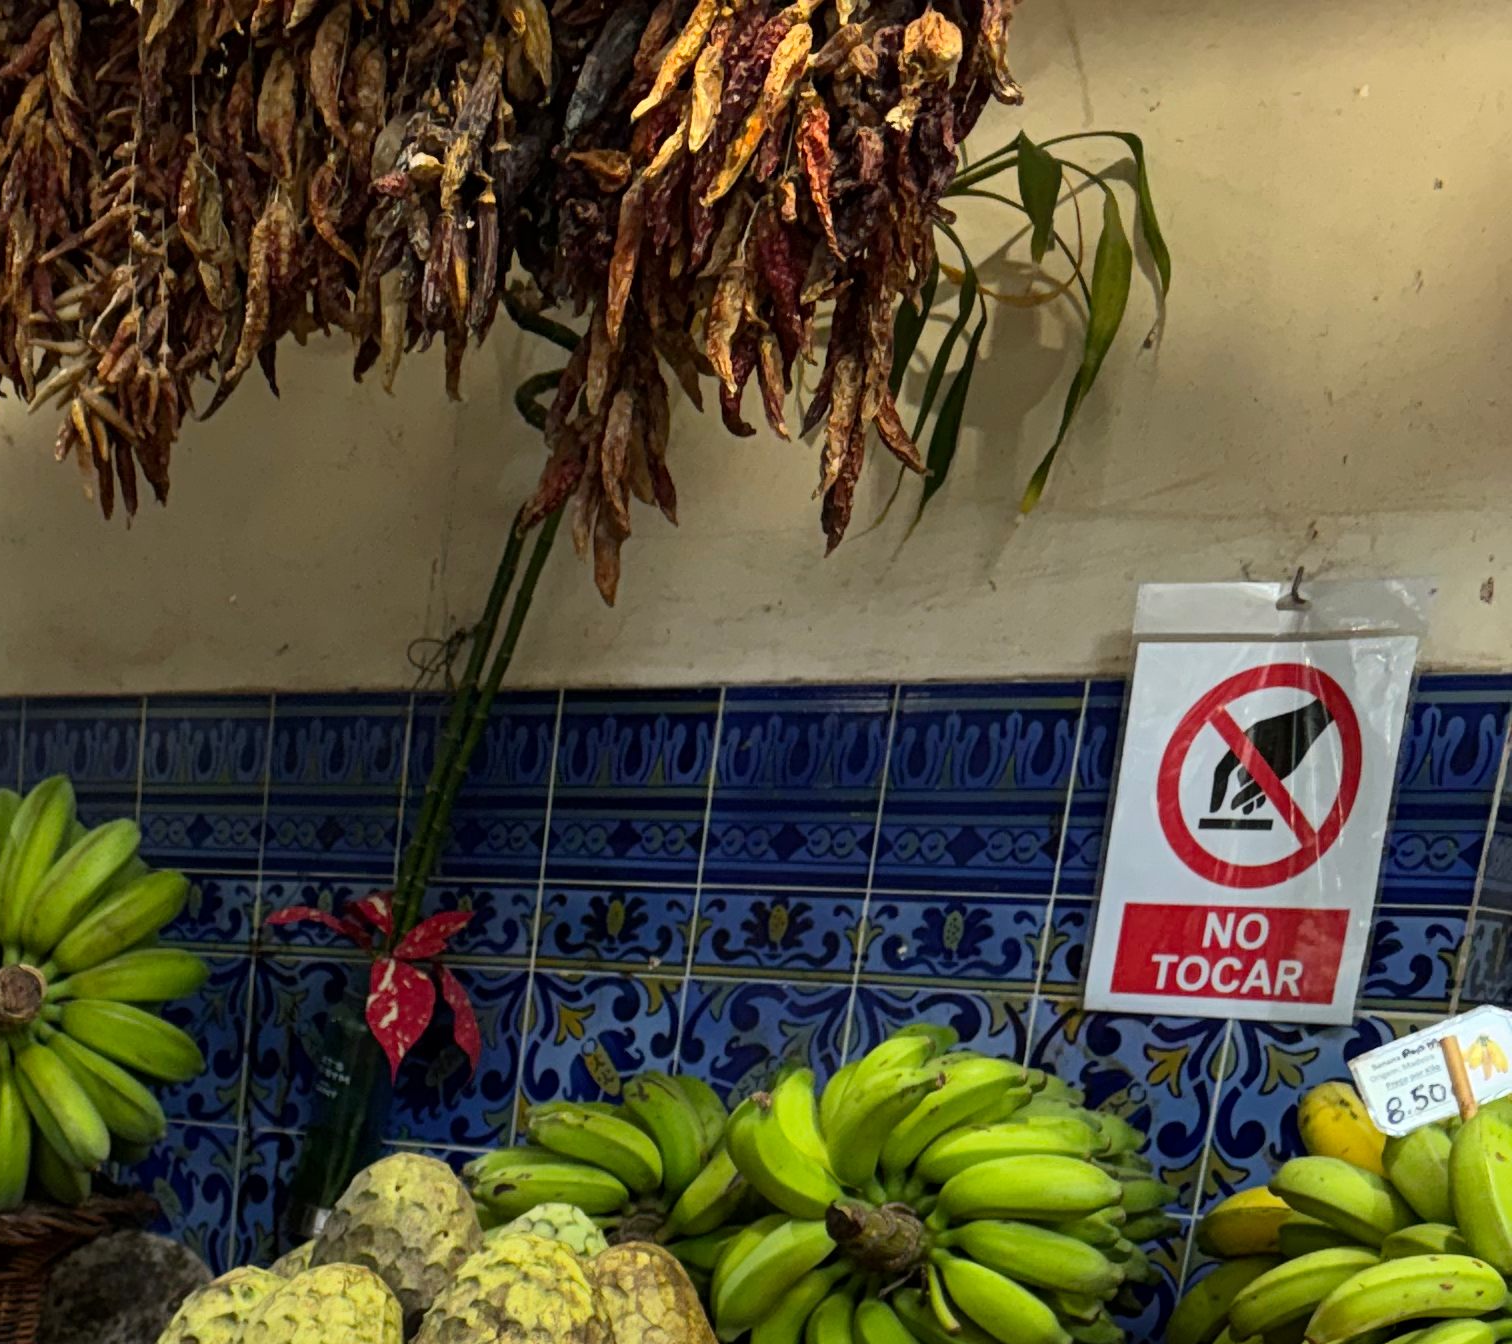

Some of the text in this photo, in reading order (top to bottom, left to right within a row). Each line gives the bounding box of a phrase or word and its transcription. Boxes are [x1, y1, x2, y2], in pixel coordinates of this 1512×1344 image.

[1202, 911, 1270, 950] NO
[1152, 954, 1304, 996] TOCAR
[1386, 1083, 1446, 1124] 8.50
